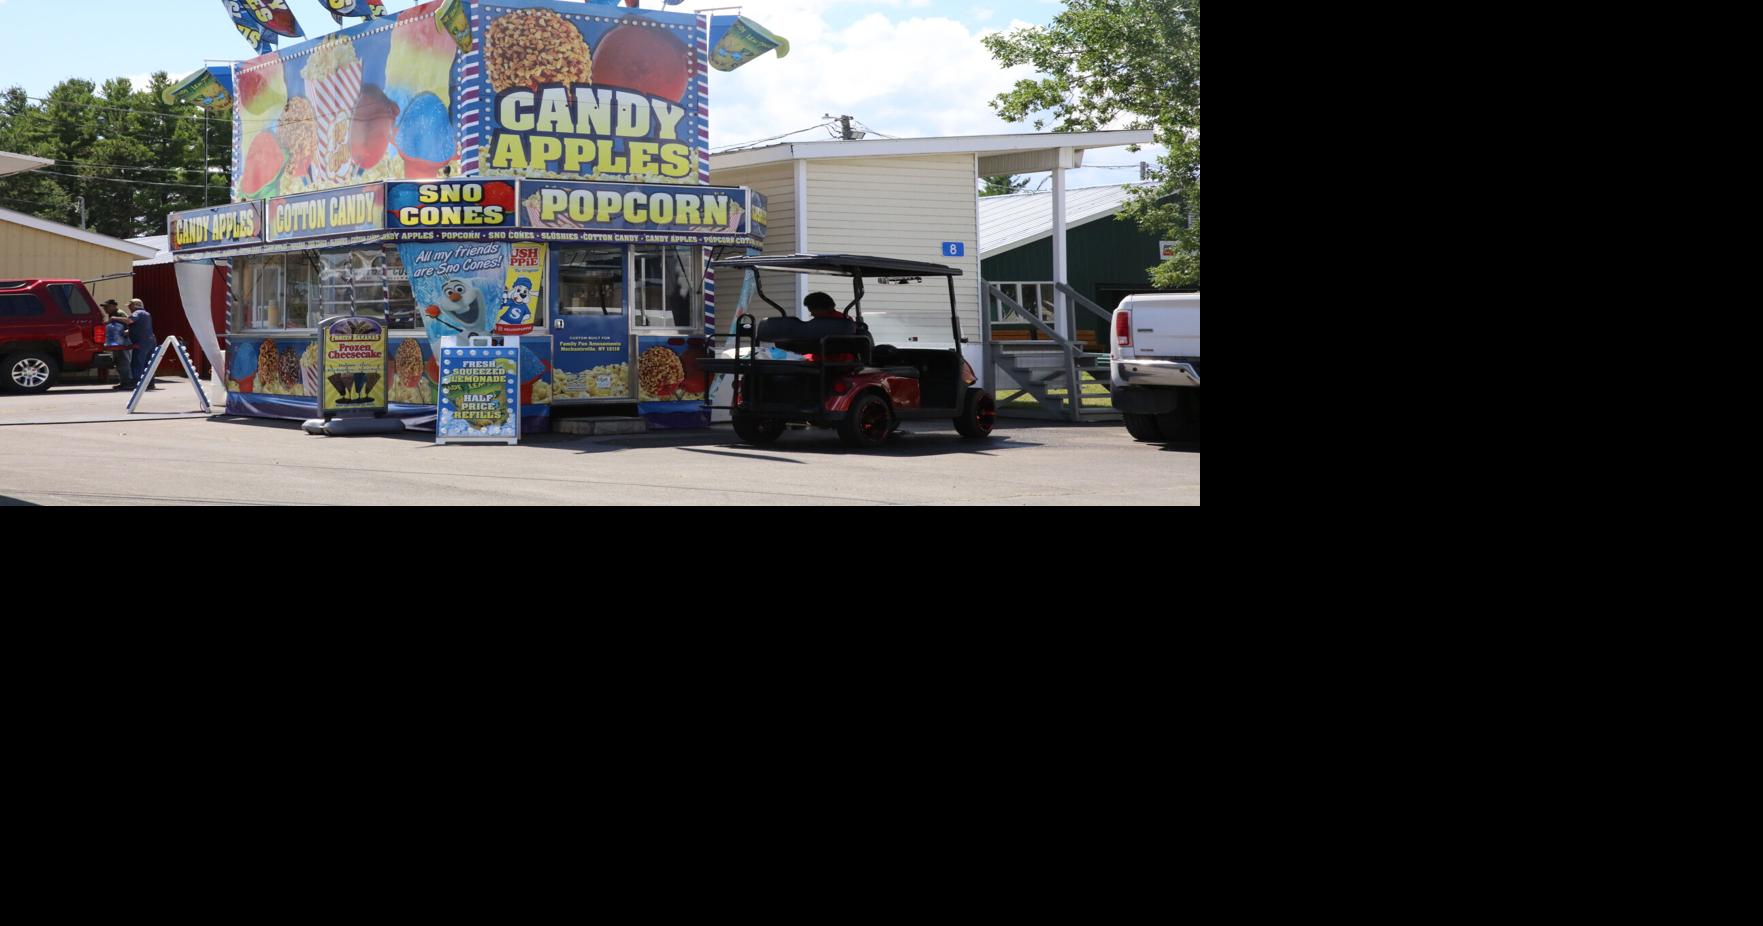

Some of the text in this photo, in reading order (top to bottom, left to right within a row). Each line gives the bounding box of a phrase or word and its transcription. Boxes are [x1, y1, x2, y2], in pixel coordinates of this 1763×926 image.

[500, 86, 685, 139] CANDY
[492, 134, 692, 178] APPLES
[419, 183, 482, 203] SNO
[275, 191, 375, 233] COTTON CANDY
[540, 188, 728, 226] POPCORN
[399, 205, 504, 226] CONES
[175, 208, 254, 244] CANDY APPLES
[402, 232, 434, 240] APPLES
[508, 231, 534, 239] CONES
[541, 231, 578, 240] SLUSHIES
[583, 233, 613, 241] COTTON
[615, 233, 639, 242] CANDY
[645, 234, 668, 242] CANDY
[671, 235, 697, 243] APPLES
[704, 235, 735, 244] POPCORN
[416, 244, 500, 262] All my friends
[949, 244, 957, 255] 8
[413, 266, 435, 278] are
[437, 263, 460, 274] Sno
[462, 256, 503, 271] Cones!
[511, 308, 522, 320] S
[339, 343, 371, 351] Frozen
[328, 350, 382, 359] Cheesecake
[462, 360, 496, 368] FRESH
[451, 375, 507, 383] LEMONADE
[464, 394, 494, 402] HALF
[461, 402, 496, 410] PRICE
[453, 411, 502, 419] REFILLS
